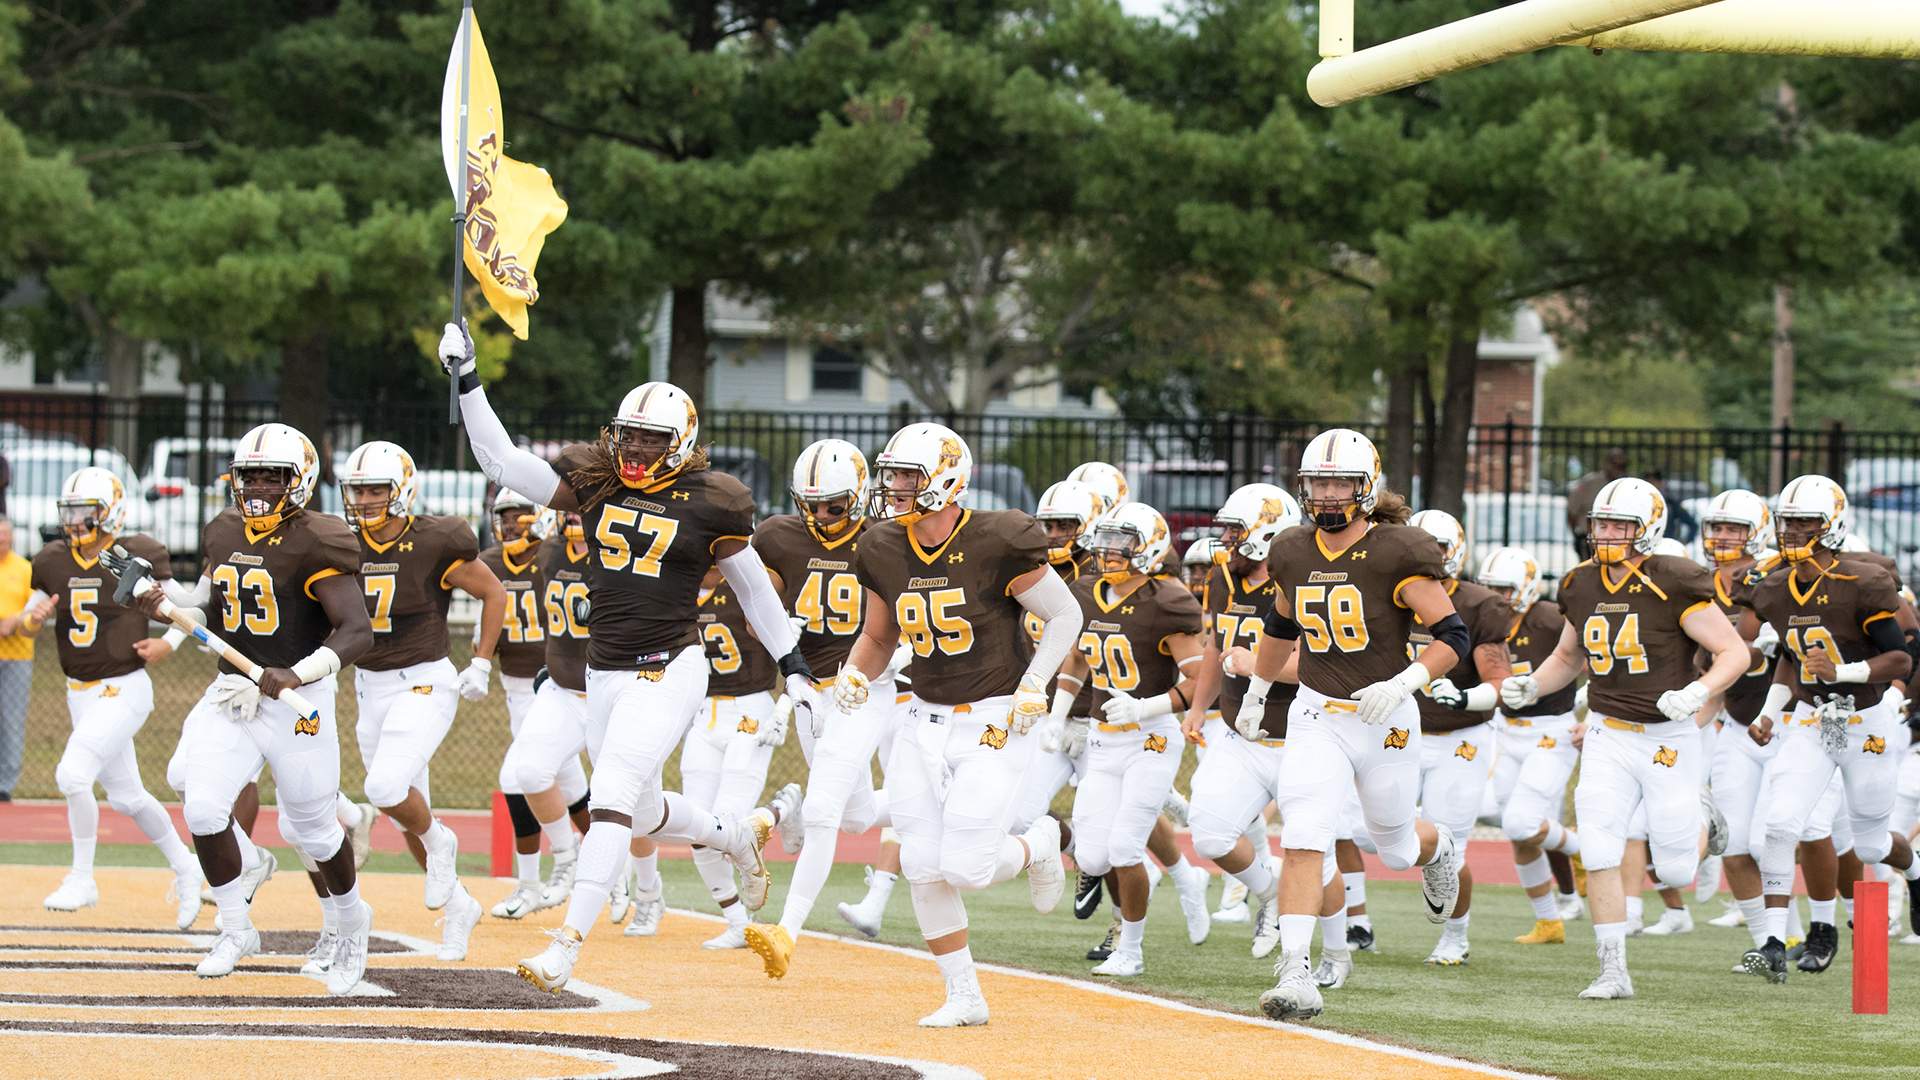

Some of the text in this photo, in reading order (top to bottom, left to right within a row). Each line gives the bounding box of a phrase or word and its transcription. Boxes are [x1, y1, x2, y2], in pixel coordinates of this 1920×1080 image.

[623, 498, 664, 513] Rowan
[230, 552, 263, 565] Rowan
[595, 503, 679, 578] 57
[809, 559, 848, 570] Rowan
[213, 564, 280, 636] 33
[364, 575, 396, 633] 7
[795, 571, 862, 635] 49
[910, 577, 948, 588] Rowan
[1310, 571, 1347, 582] Rowan
[68, 588, 99, 648] 5
[501, 590, 545, 643] 41
[895, 587, 975, 658] 85
[1089, 621, 1120, 632] Rowan
[1295, 584, 1370, 654] 58
[1596, 603, 1628, 612] Rowan
[699, 623, 742, 674] 3
[1078, 632, 1141, 691] 20
[1583, 613, 1649, 675] 94
